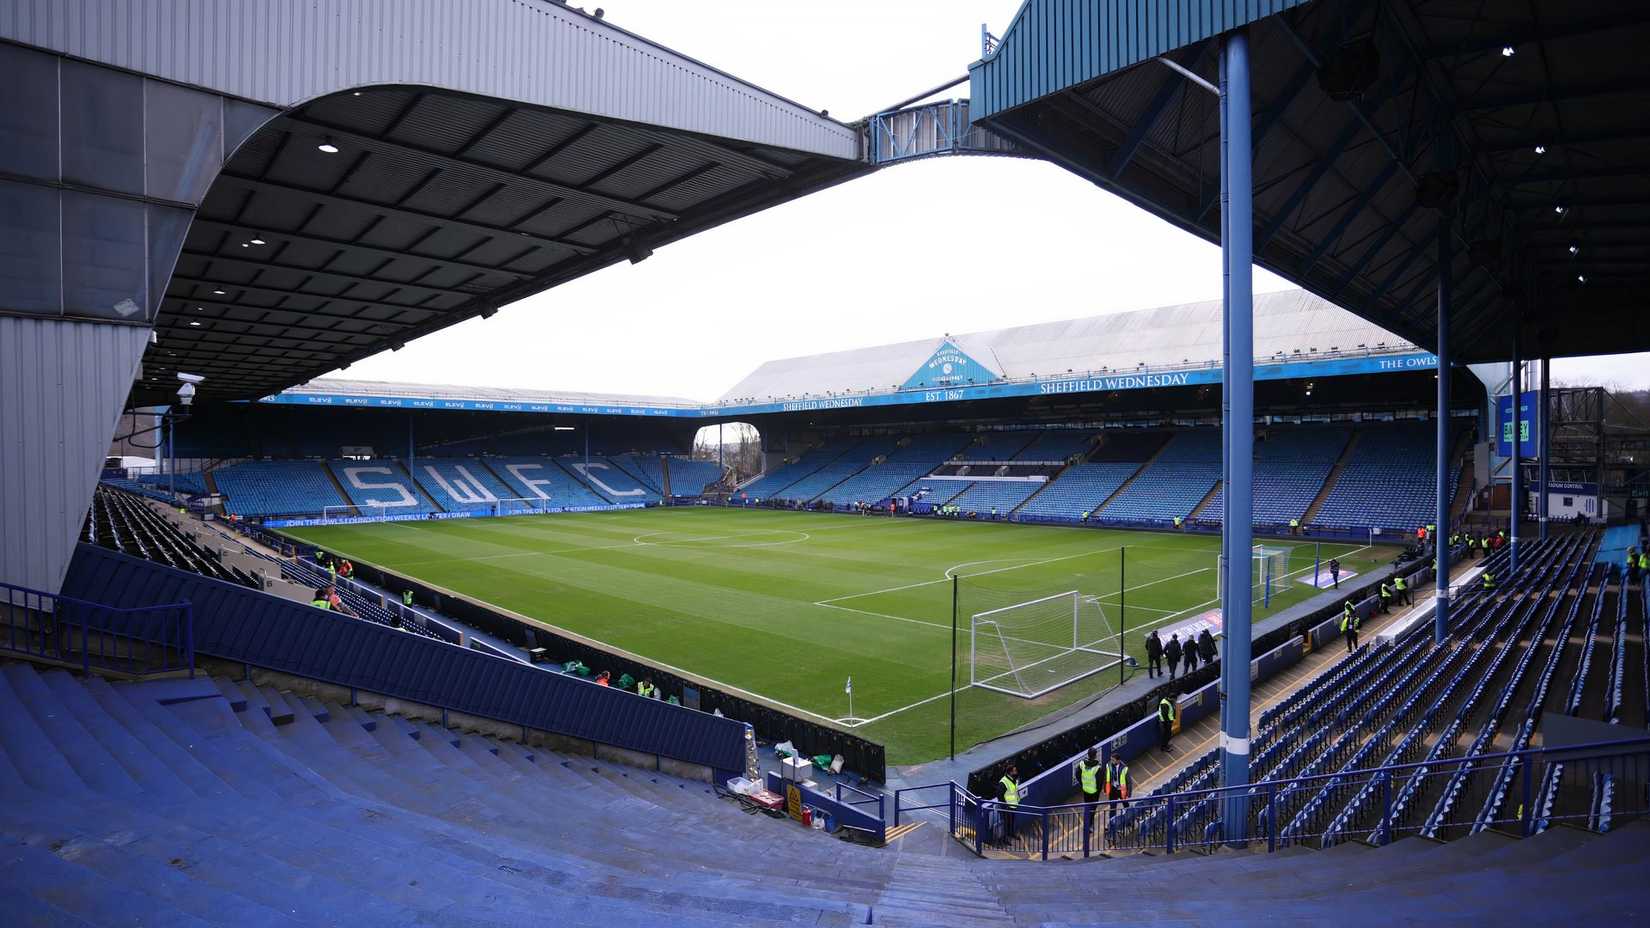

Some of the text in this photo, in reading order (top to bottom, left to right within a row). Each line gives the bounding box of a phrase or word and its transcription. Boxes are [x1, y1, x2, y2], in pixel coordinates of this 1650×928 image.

[1379, 356, 1437, 369] THE OWLS
[1040, 373, 1189, 394] SHEFFIELD WEDNESDAY
[945, 390, 964, 400] 1867
[783, 398, 864, 412] SHEFFIELD WEDNESDAY
[344, 465, 646, 508] SWFC
